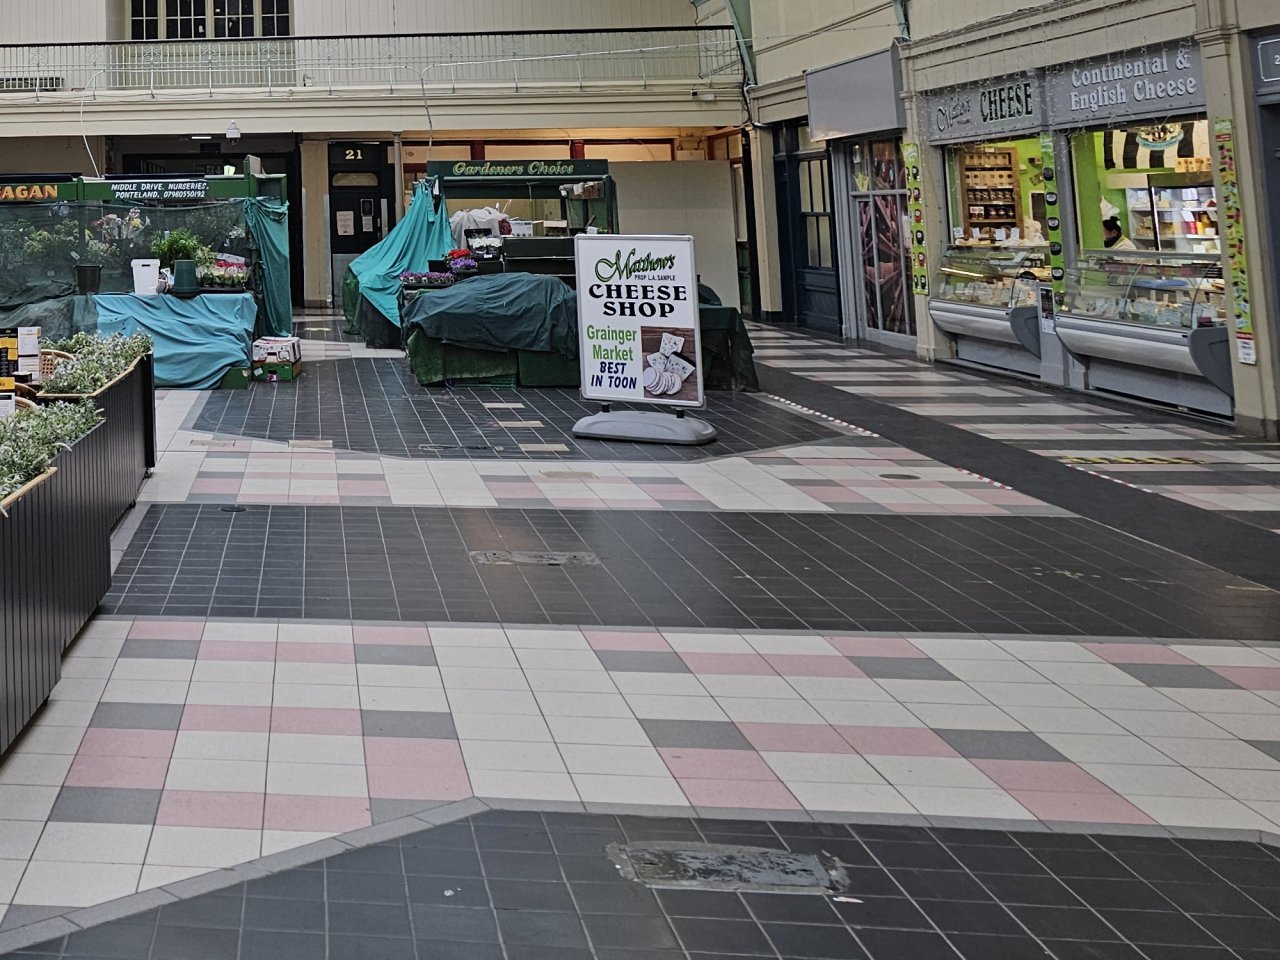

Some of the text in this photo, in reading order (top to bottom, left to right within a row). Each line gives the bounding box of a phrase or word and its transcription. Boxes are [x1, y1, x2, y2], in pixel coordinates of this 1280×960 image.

[1071, 48, 1192, 88] Continental &
[1070, 77, 1197, 112] English Cheese
[980, 82, 1034, 123] CHEESE
[345, 149, 363, 160] 21
[452, 161, 574, 176] Gardeners Choice
[111, 183, 137, 191] MIDDLE
[588, 284, 687, 302] CHEESE
[602, 302, 675, 317] SHOP
[586, 324, 637, 344] Grainger
[592, 345, 634, 361] Market
[599, 361, 627, 375] BEST
[590, 375, 637, 390] IN TOON
